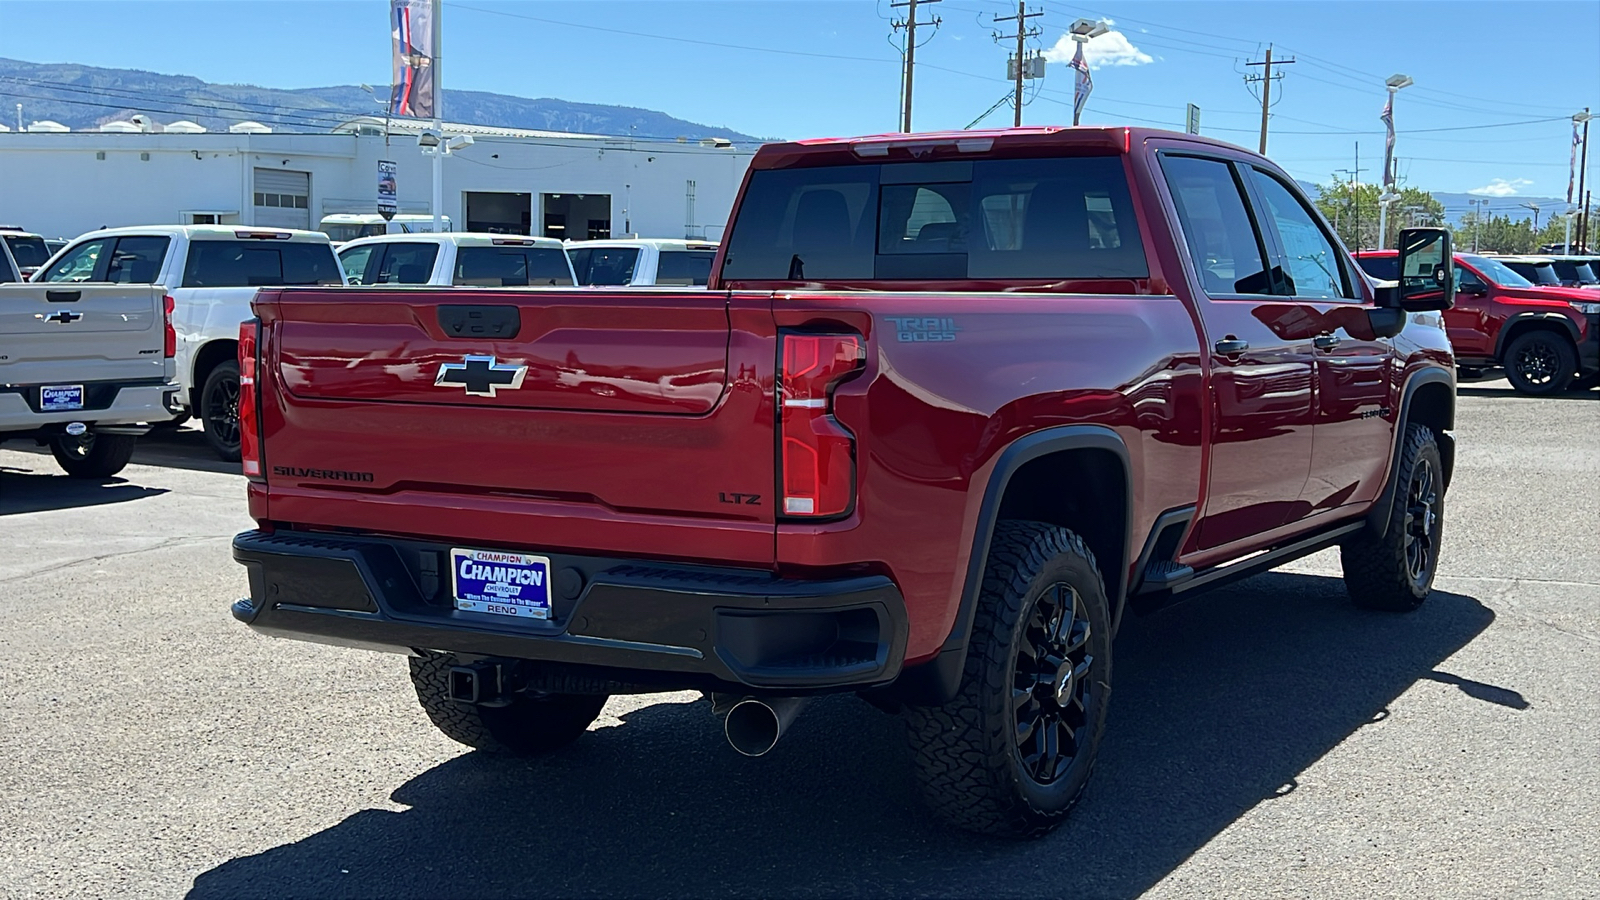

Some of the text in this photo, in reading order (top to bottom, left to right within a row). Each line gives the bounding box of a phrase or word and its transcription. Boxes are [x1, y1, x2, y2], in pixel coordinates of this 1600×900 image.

[883, 316, 963, 331] TRAIL
[897, 331, 956, 342] BOSS
[43, 389, 80, 399] CHAMPION
[273, 465, 375, 482] SILVERADO
[718, 492, 762, 506] LTZ
[476, 552, 522, 564] CHAMPION
[460, 559, 543, 587] CHAMPION
[486, 584, 519, 595] CHEVROLET
[487, 604, 517, 615] RENO
